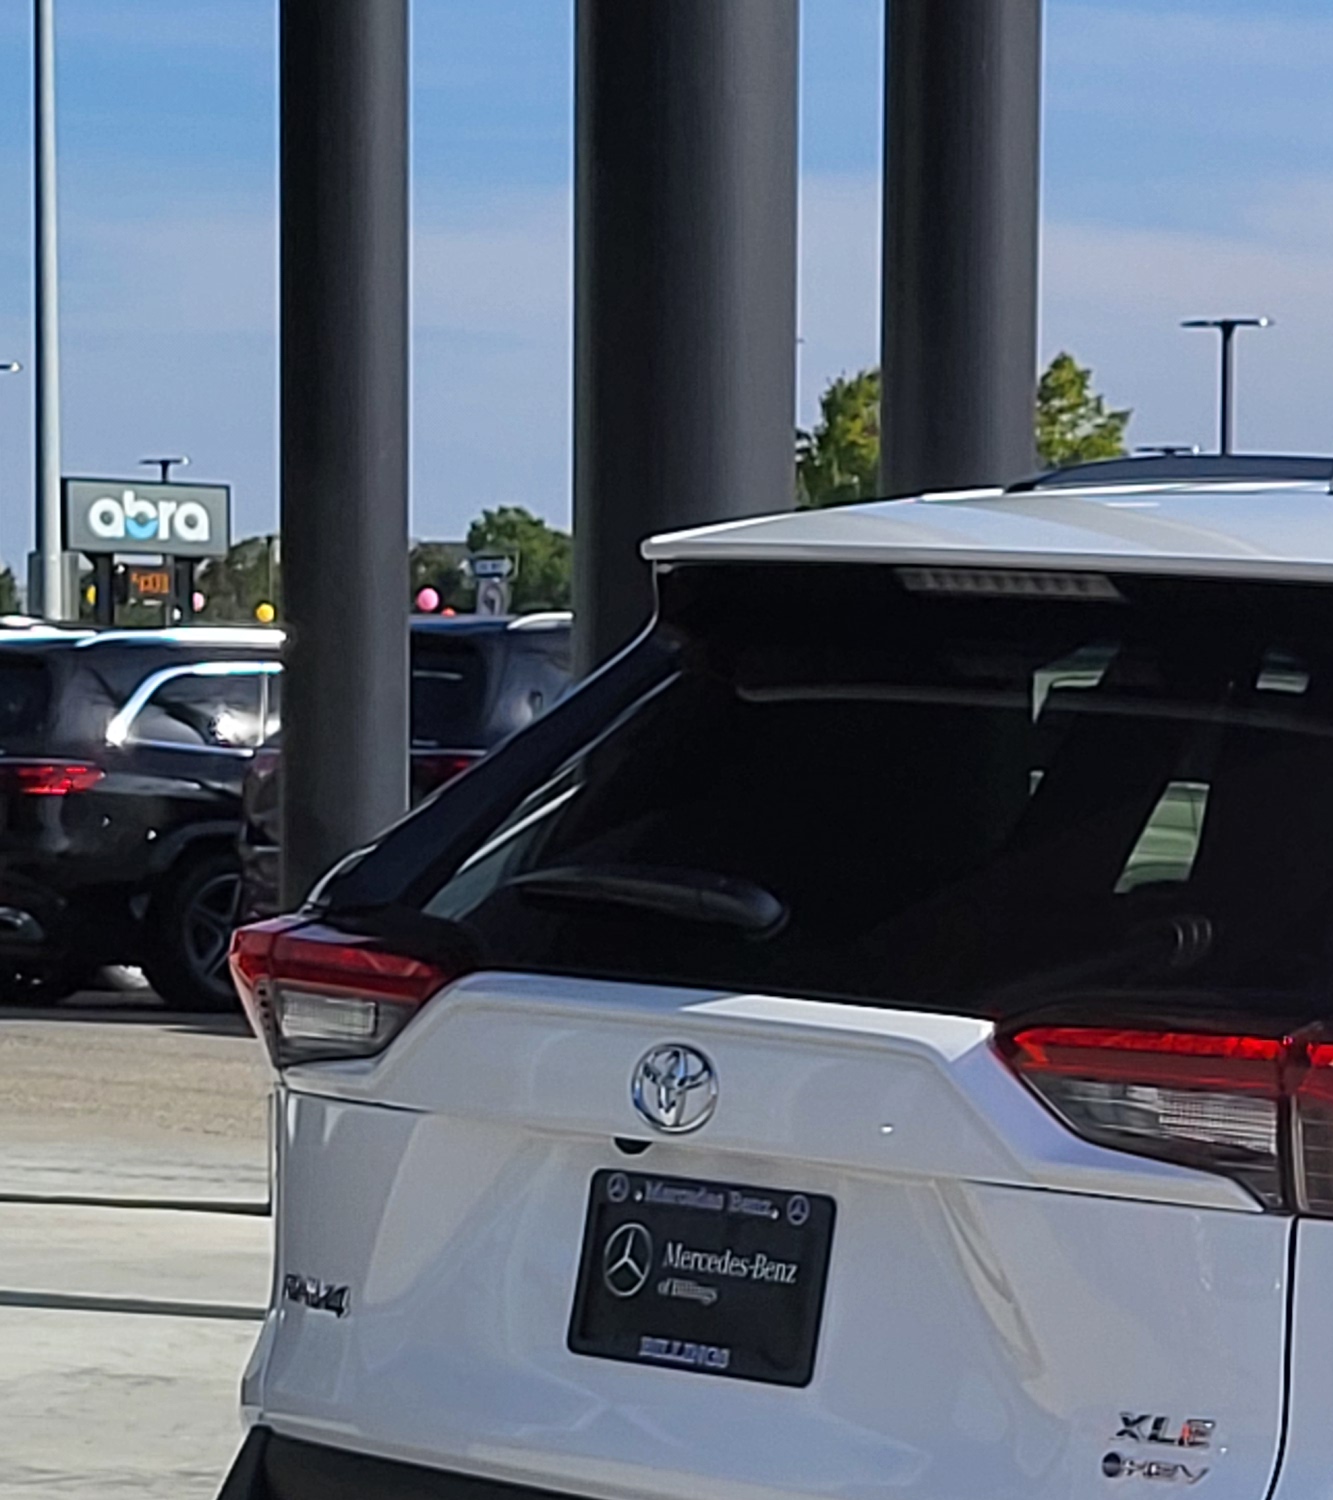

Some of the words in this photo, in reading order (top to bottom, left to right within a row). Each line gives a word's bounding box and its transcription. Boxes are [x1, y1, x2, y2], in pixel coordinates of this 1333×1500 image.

[89, 490, 210, 542] abra
[662, 1241, 798, 1284] Mercedes-Benz
[1114, 1411, 1215, 1447] XLE
